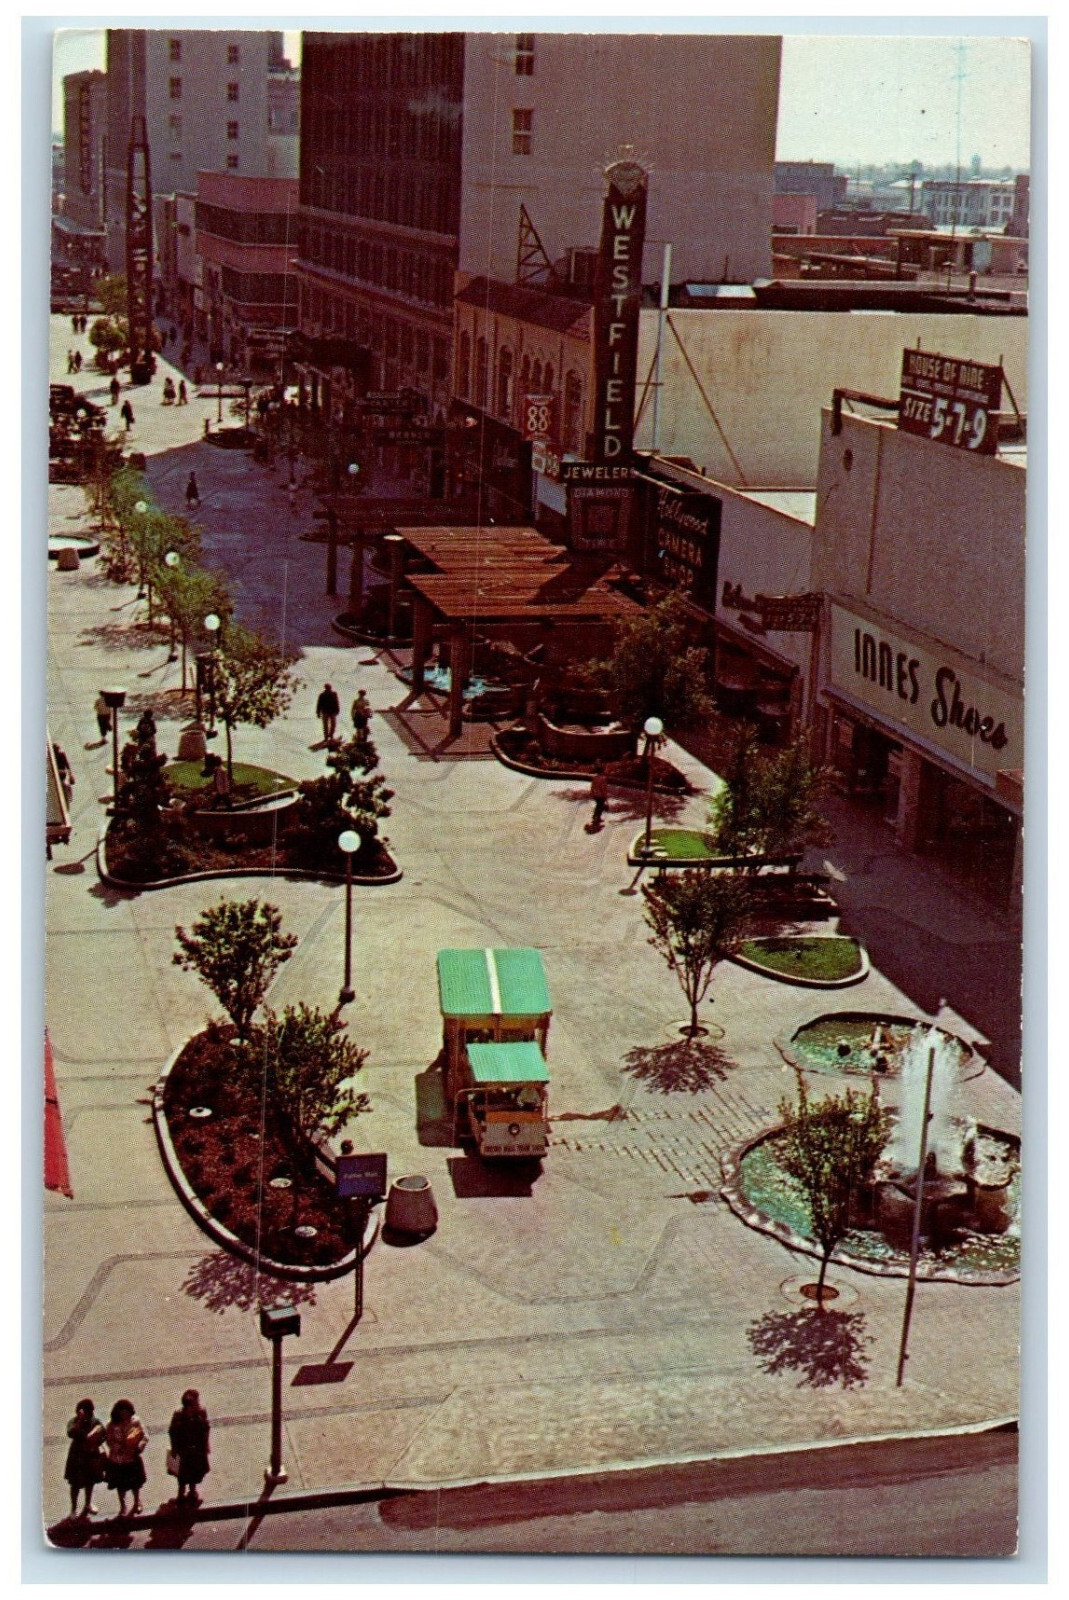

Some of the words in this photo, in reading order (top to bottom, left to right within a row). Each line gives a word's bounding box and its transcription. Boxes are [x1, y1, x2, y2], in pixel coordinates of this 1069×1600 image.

[603, 205, 636, 456] WESTFIELD
[909, 354, 941, 379] HOUSE
[943, 361, 957, 381] OF
[527, 405, 548, 431] 88
[903, 397, 932, 422] SIZE
[930, 398, 988, 449] 5-7-9
[563, 466, 638, 479] JEWELERS
[658, 527, 702, 567] CAMERA
[663, 555, 694, 586] SHOP
[854, 628, 920, 704] INNES
[930, 666, 1009, 750] Shoes
